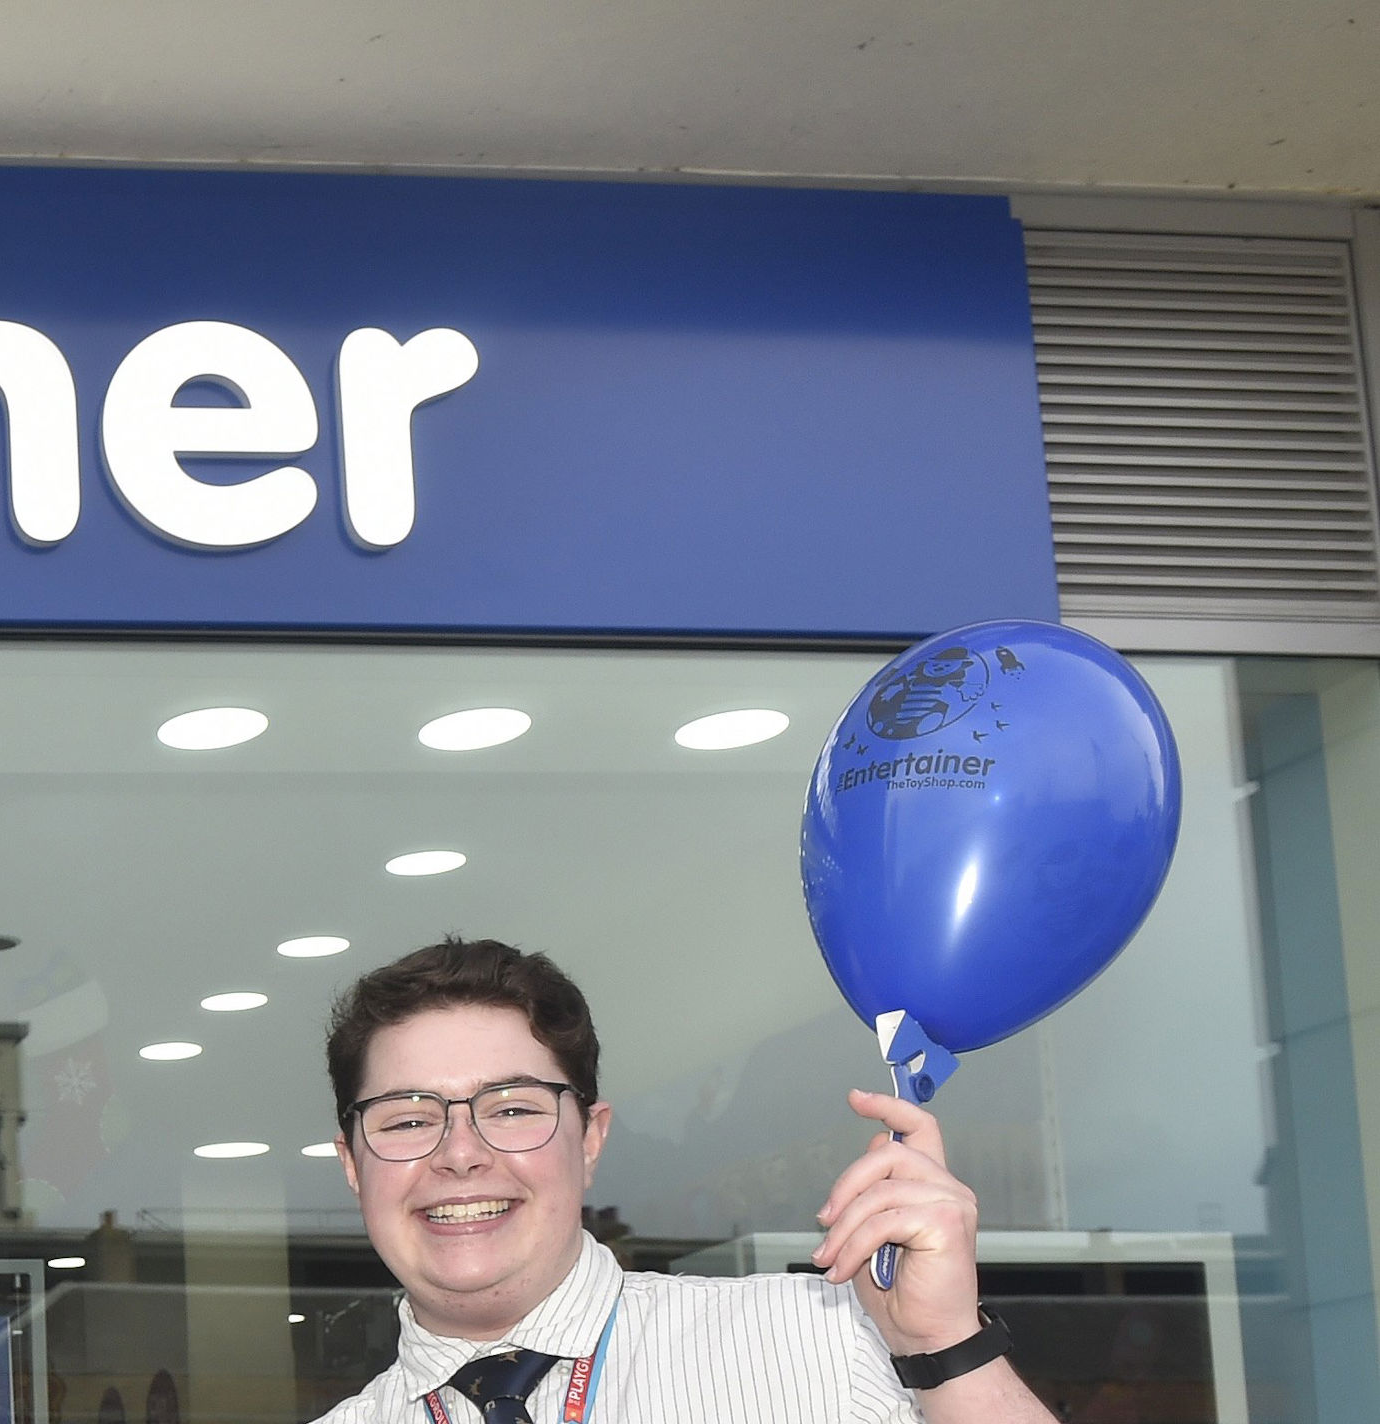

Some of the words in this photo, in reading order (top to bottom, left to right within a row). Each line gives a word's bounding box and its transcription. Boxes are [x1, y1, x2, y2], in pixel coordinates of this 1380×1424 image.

[843, 748, 996, 791] Entertainer
[887, 776, 986, 791] TheToyShop.com
[570, 1355, 592, 1405] PLAYG
